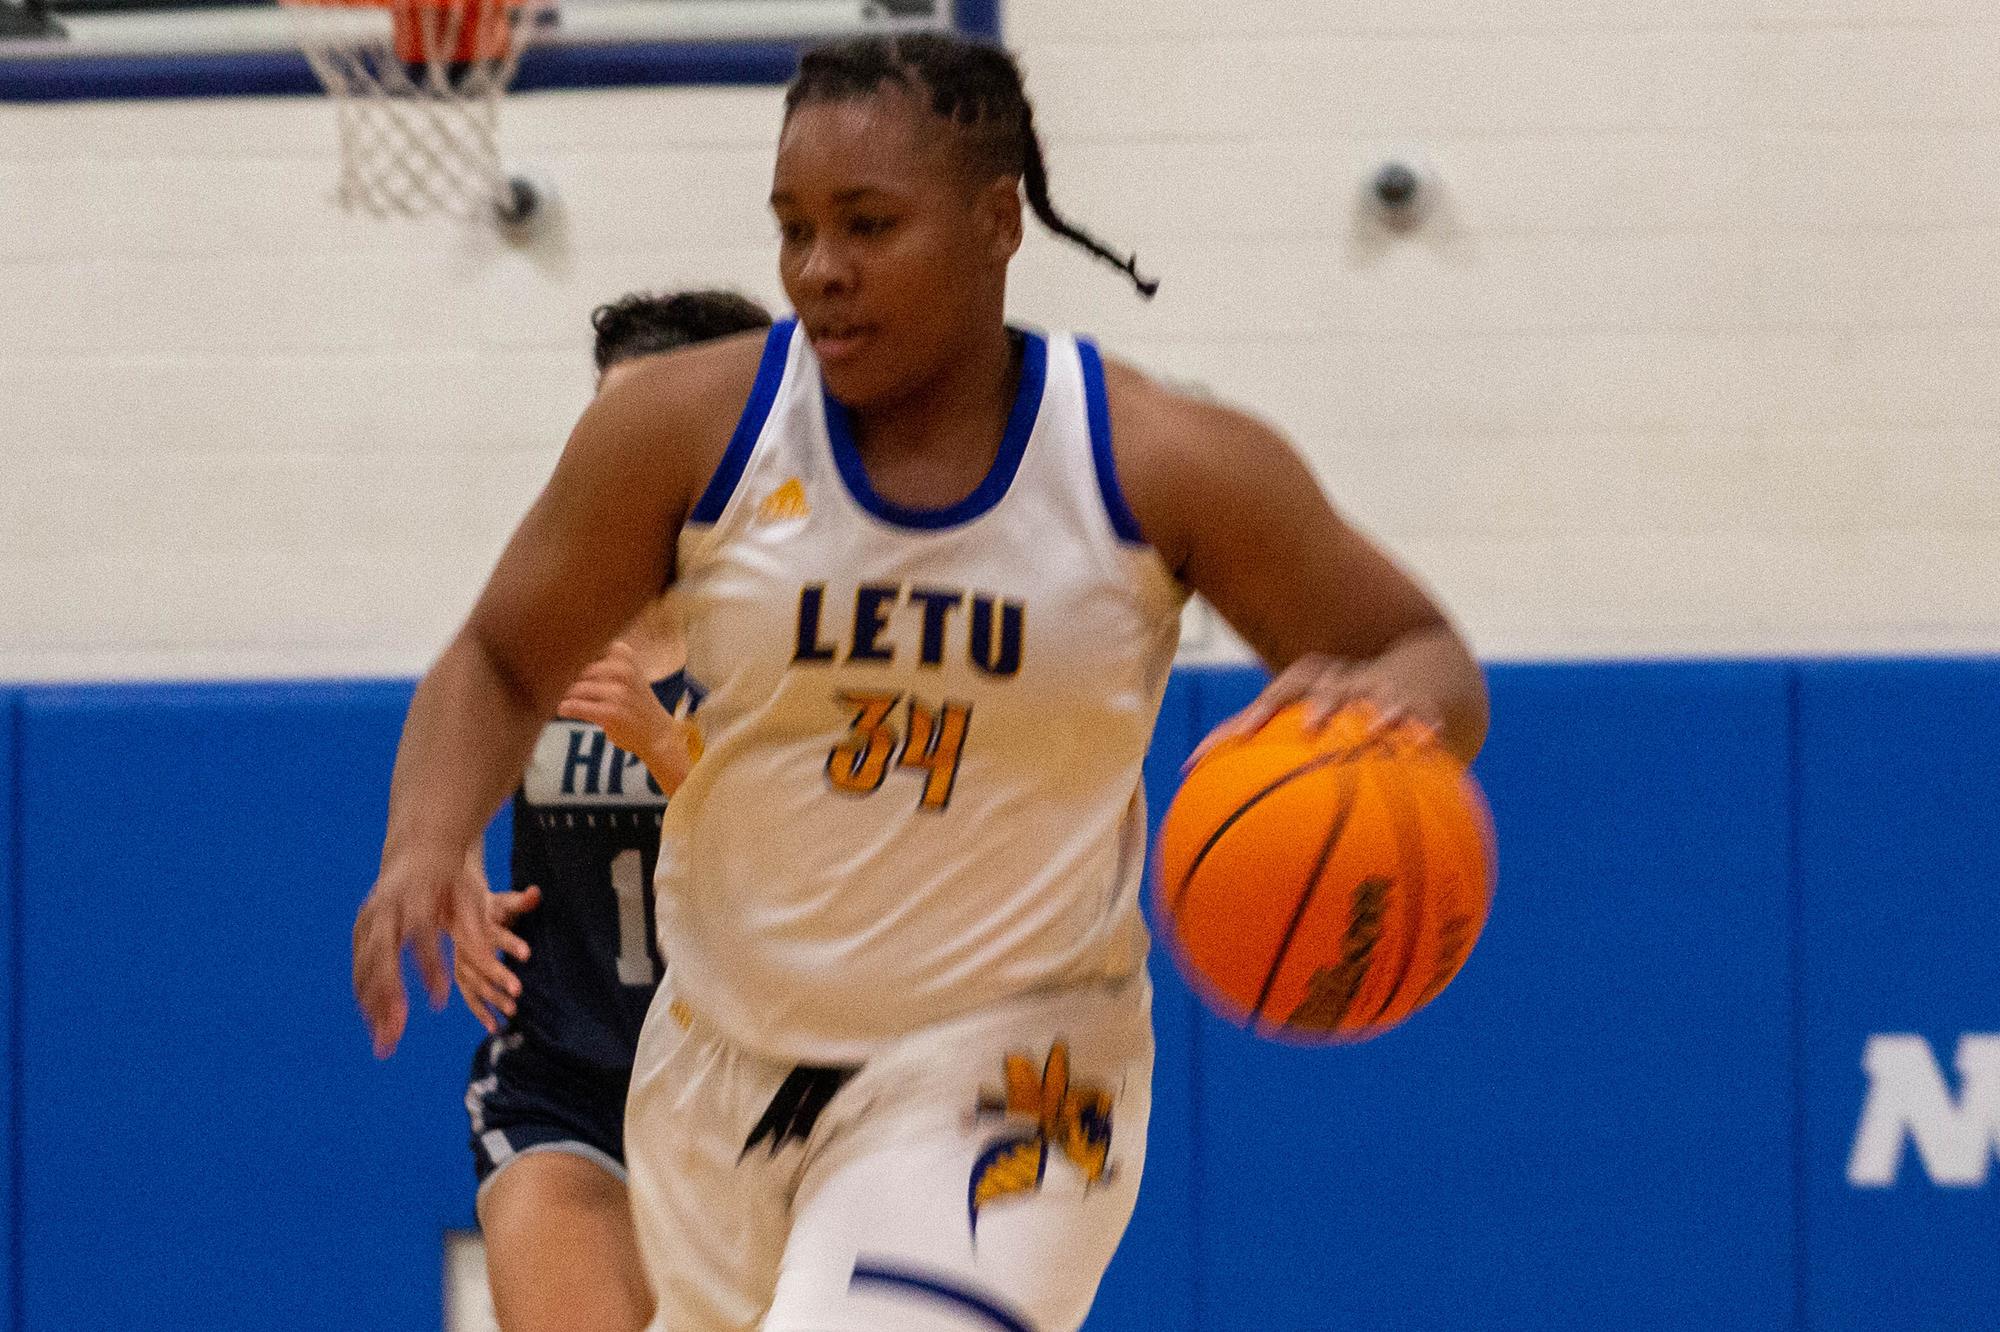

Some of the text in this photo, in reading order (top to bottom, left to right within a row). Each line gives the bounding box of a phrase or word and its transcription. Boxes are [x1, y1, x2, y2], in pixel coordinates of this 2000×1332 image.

[792, 583, 1025, 677] LETU
[561, 730, 664, 795] HP
[824, 691, 972, 810] 34
